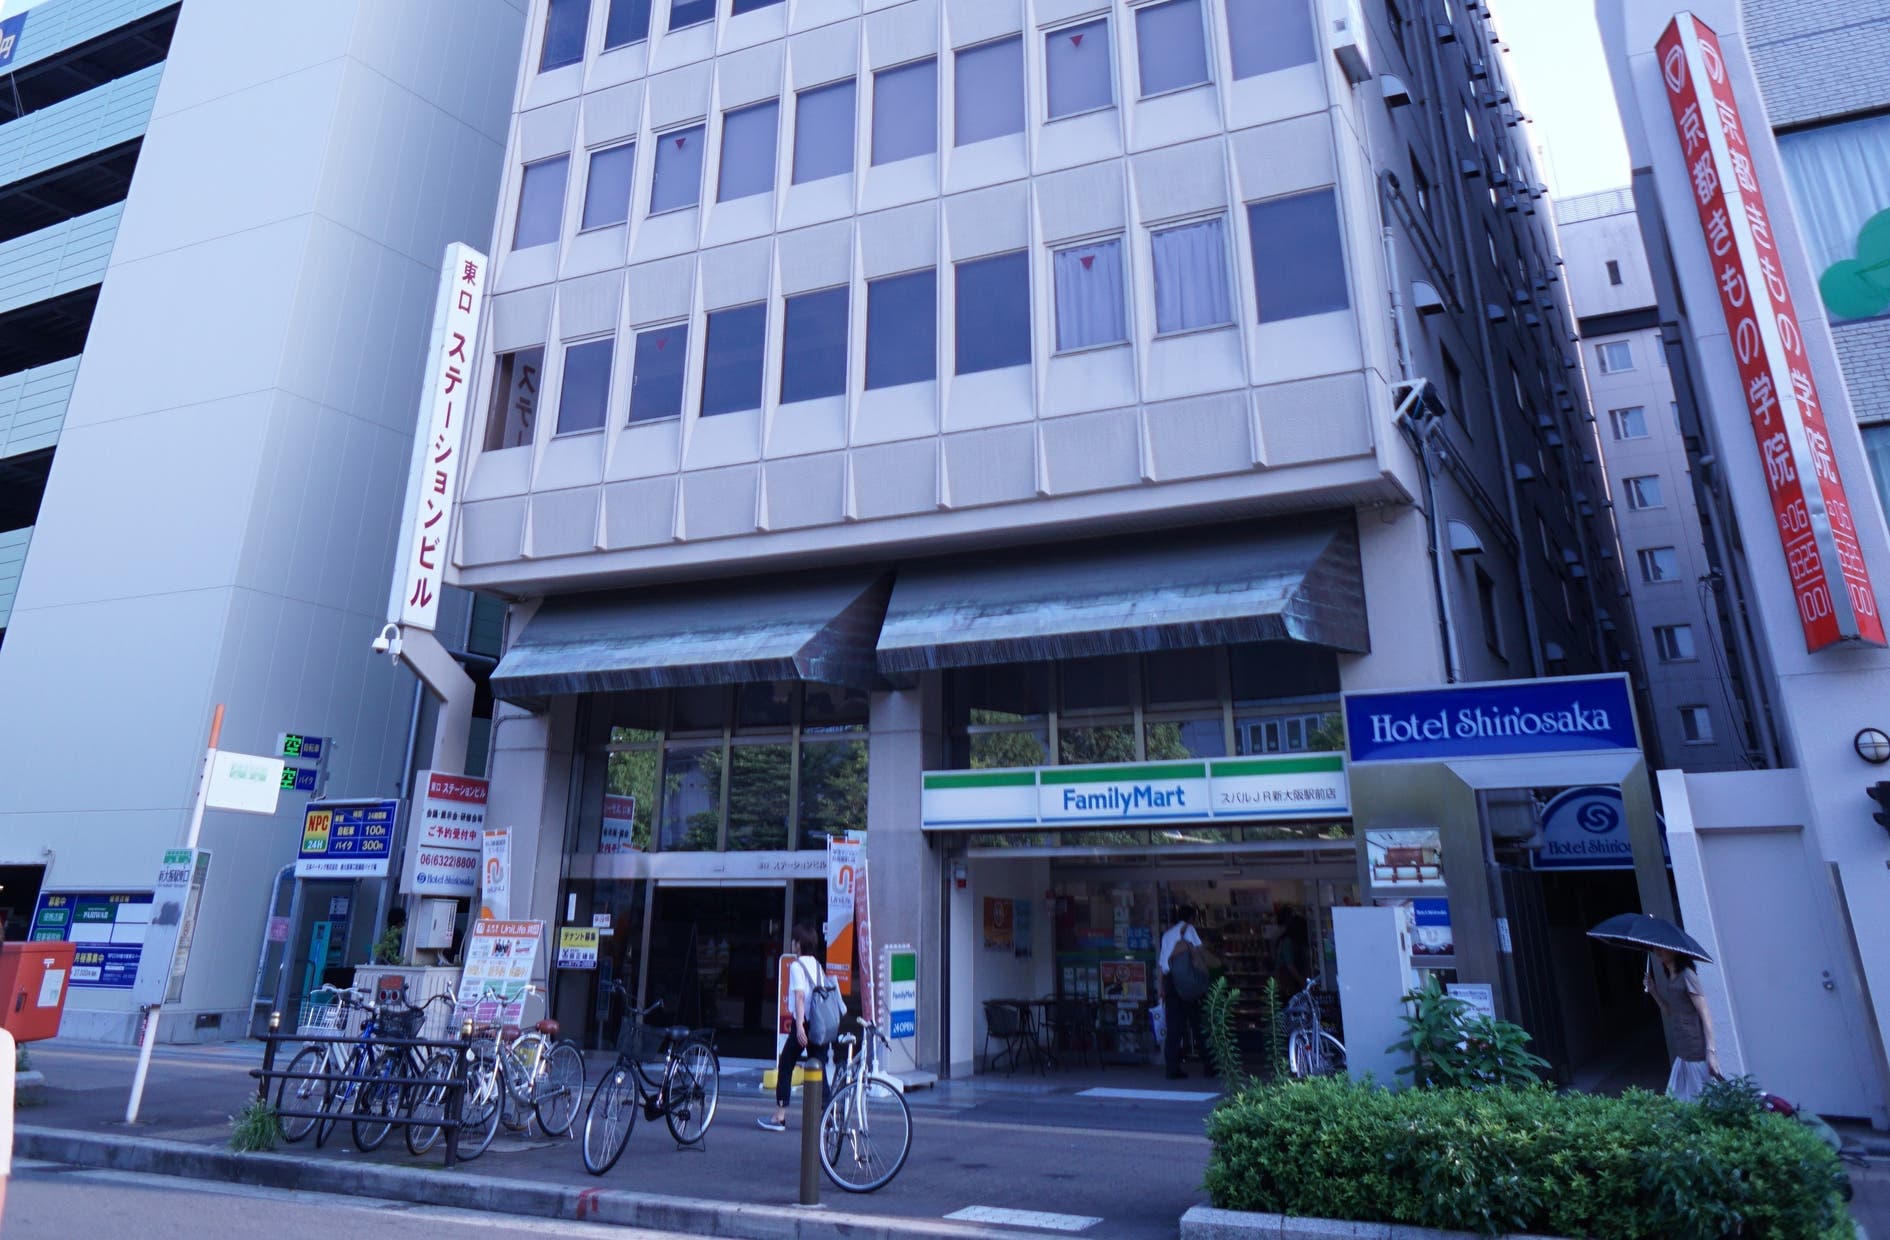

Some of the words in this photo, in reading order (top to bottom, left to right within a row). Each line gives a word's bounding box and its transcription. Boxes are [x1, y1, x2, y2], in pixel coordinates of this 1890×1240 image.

[458, 260, 478, 315] 東口
[1715, 99, 1837, 484] 京都きもの学院
[1680, 102, 1796, 491] 京都きもの学院
[410, 331, 474, 608] ステーションビル
[1786, 498, 1808, 533] 06
[1788, 541, 1821, 579] 6325
[1369, 709, 1450, 743] Hotel
[1455, 700, 1611, 738] Shin'osaka
[285, 735, 302, 757] 空
[298, 776, 314, 785] バイク
[430, 781, 441, 791] 東口
[442, 784, 487, 799] ステーションビル
[1063, 785, 1186, 817] FamilyMart
[308, 814, 329, 832] NPC
[337, 826, 355, 836] 自転車
[365, 825, 386, 836] 100円
[428, 825, 477, 841] ご予約受付中
[306, 840, 323, 850] 24H
[335, 841, 353, 850] バイク
[362, 840, 384, 851] 300円
[1548, 841, 1586, 855] Hotel
[1588, 839, 1631, 854] Shin'o
[420, 853, 477, 869] 06(6322)8800
[563, 930, 596, 941] テナント募集
[900, 1021, 914, 1032] OPEN
